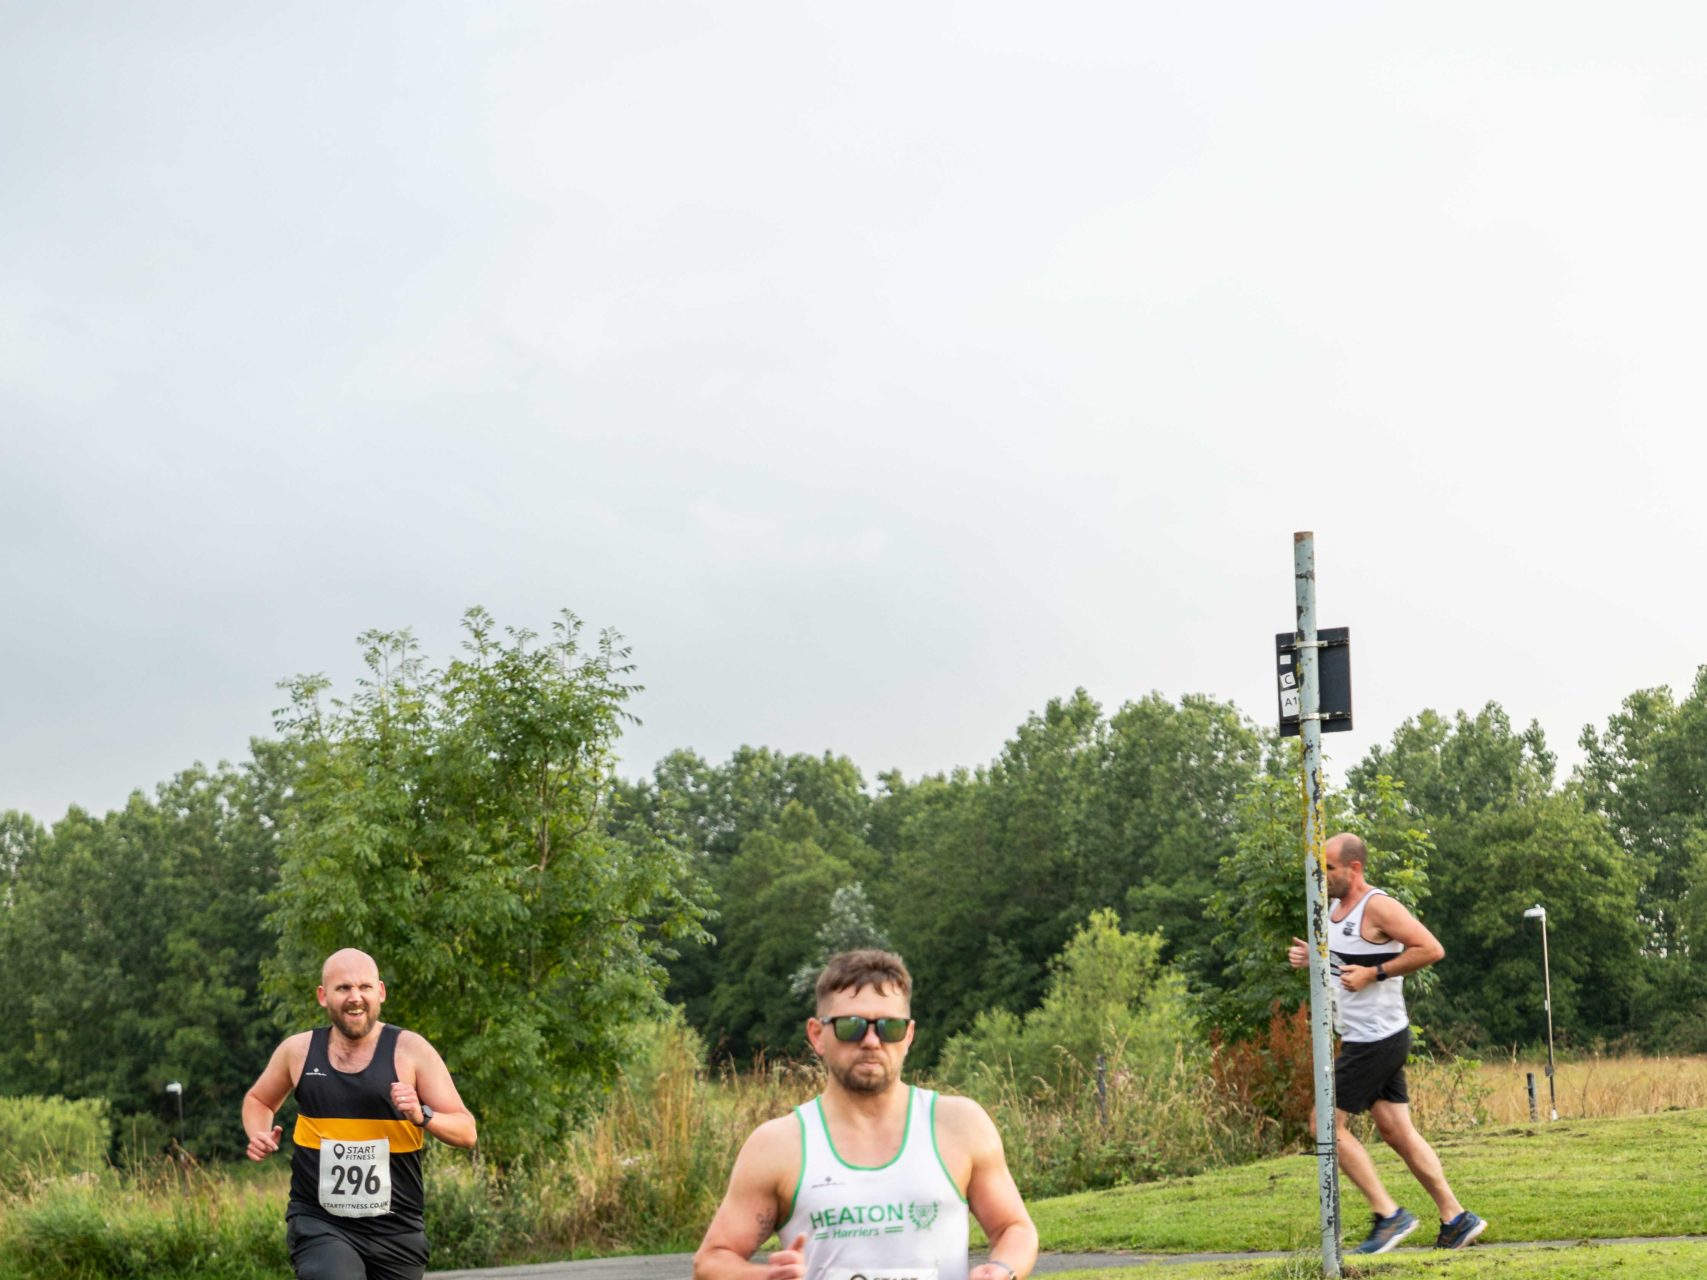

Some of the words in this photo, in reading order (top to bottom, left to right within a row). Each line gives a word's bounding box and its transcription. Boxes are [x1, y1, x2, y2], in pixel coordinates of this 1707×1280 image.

[346, 1145, 376, 1154] START
[331, 1164, 381, 1195] 296
[809, 1202, 904, 1229] HEATON
[832, 1227, 880, 1239] Harriers
